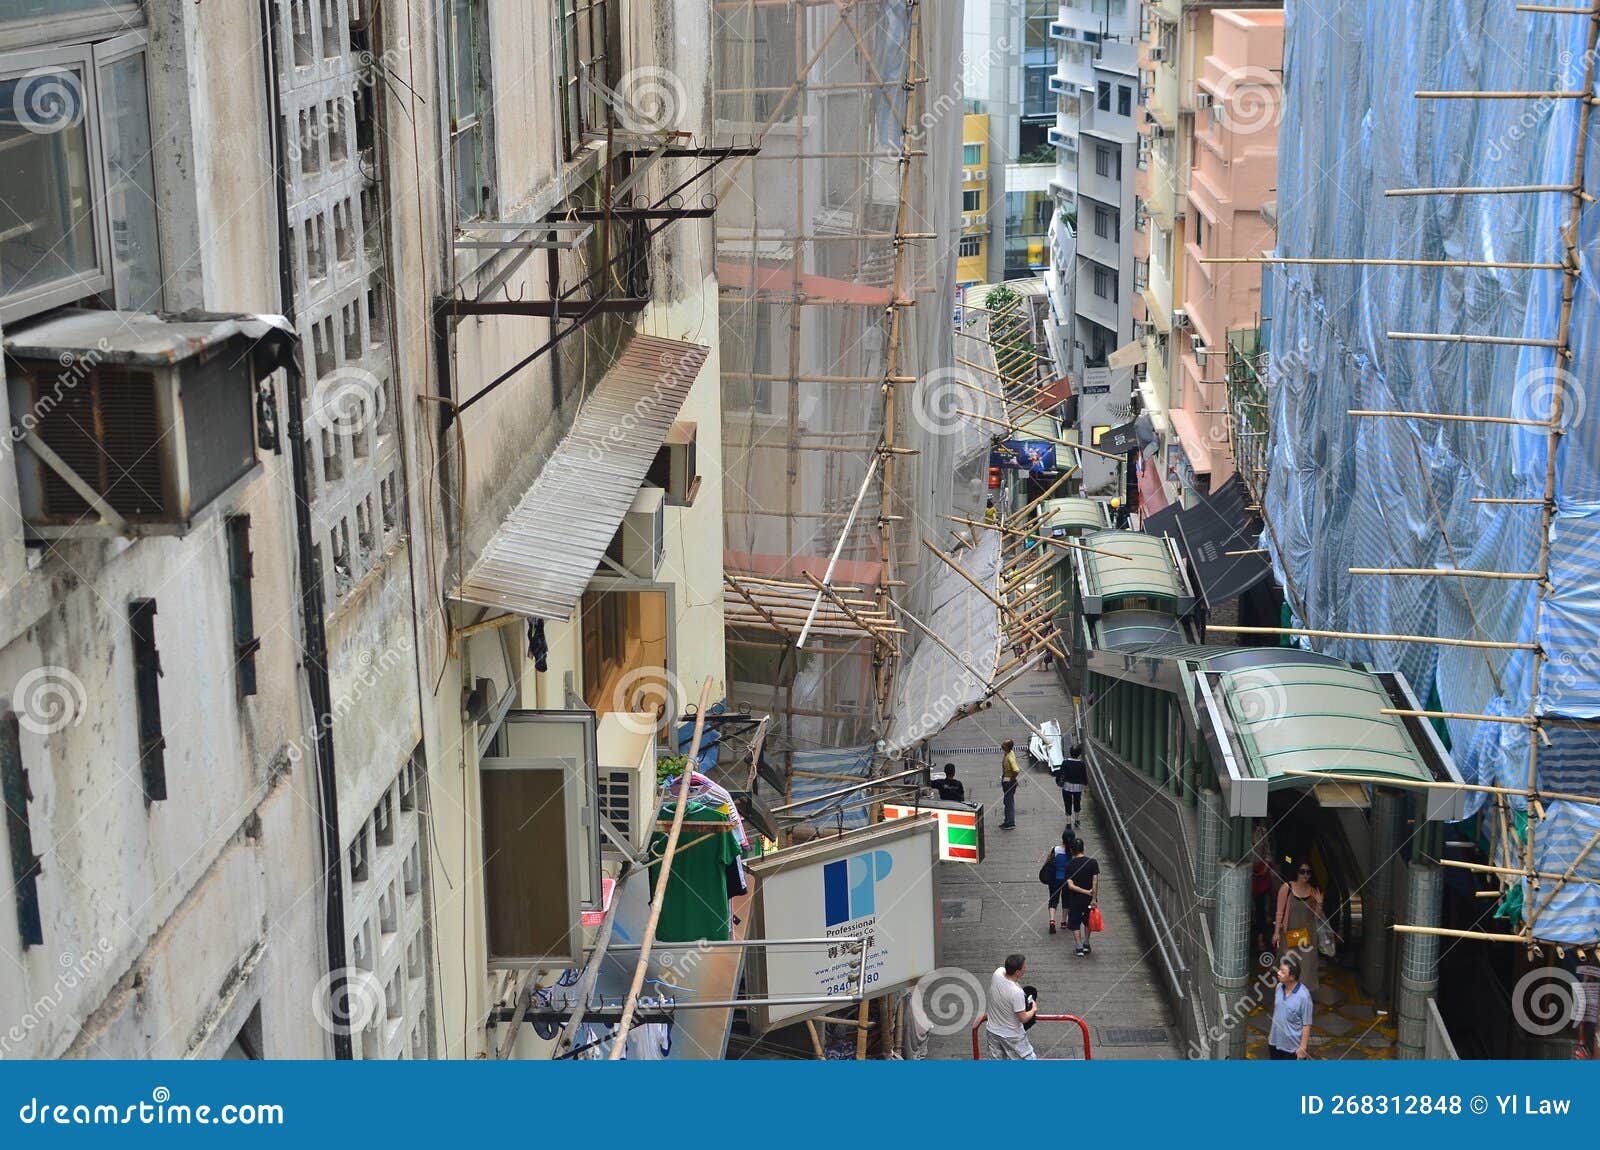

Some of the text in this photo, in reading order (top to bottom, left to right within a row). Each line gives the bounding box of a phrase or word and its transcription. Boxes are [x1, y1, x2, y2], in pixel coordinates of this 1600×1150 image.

[826, 916, 876, 938] Professional
[827, 972, 879, 996] 2840 180
